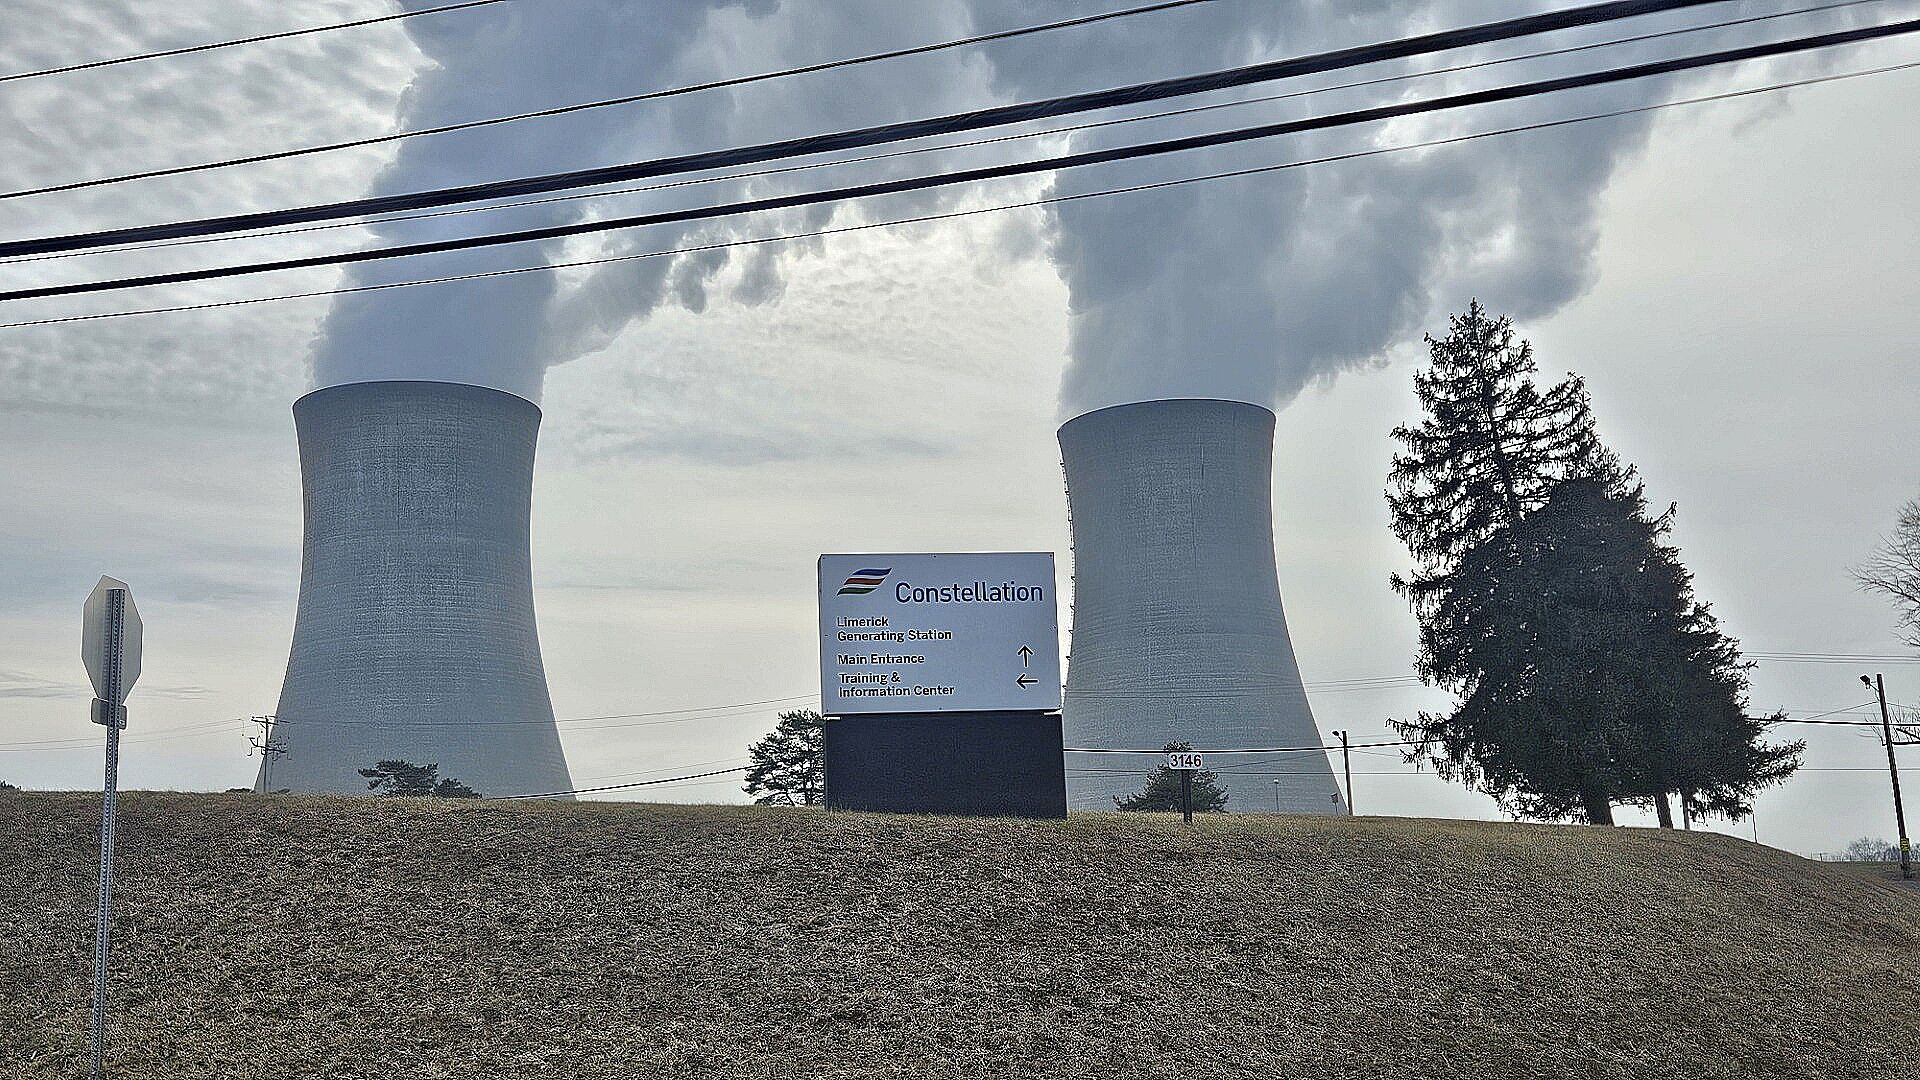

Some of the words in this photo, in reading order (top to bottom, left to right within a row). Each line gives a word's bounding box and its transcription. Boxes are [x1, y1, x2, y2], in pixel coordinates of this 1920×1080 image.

[895, 581, 1043, 603] Constellation
[837, 616, 889, 627] Limerick
[837, 631, 904, 643] Generating
[908, 630, 952, 641] Station
[838, 654, 867, 665] Main
[871, 654, 925, 664] Entrance
[839, 673, 888, 685] Training
[891, 672, 901, 683] &
[839, 687, 911, 698] Information
[914, 686, 955, 696] Center
[1170, 754, 1202, 767] 3146
